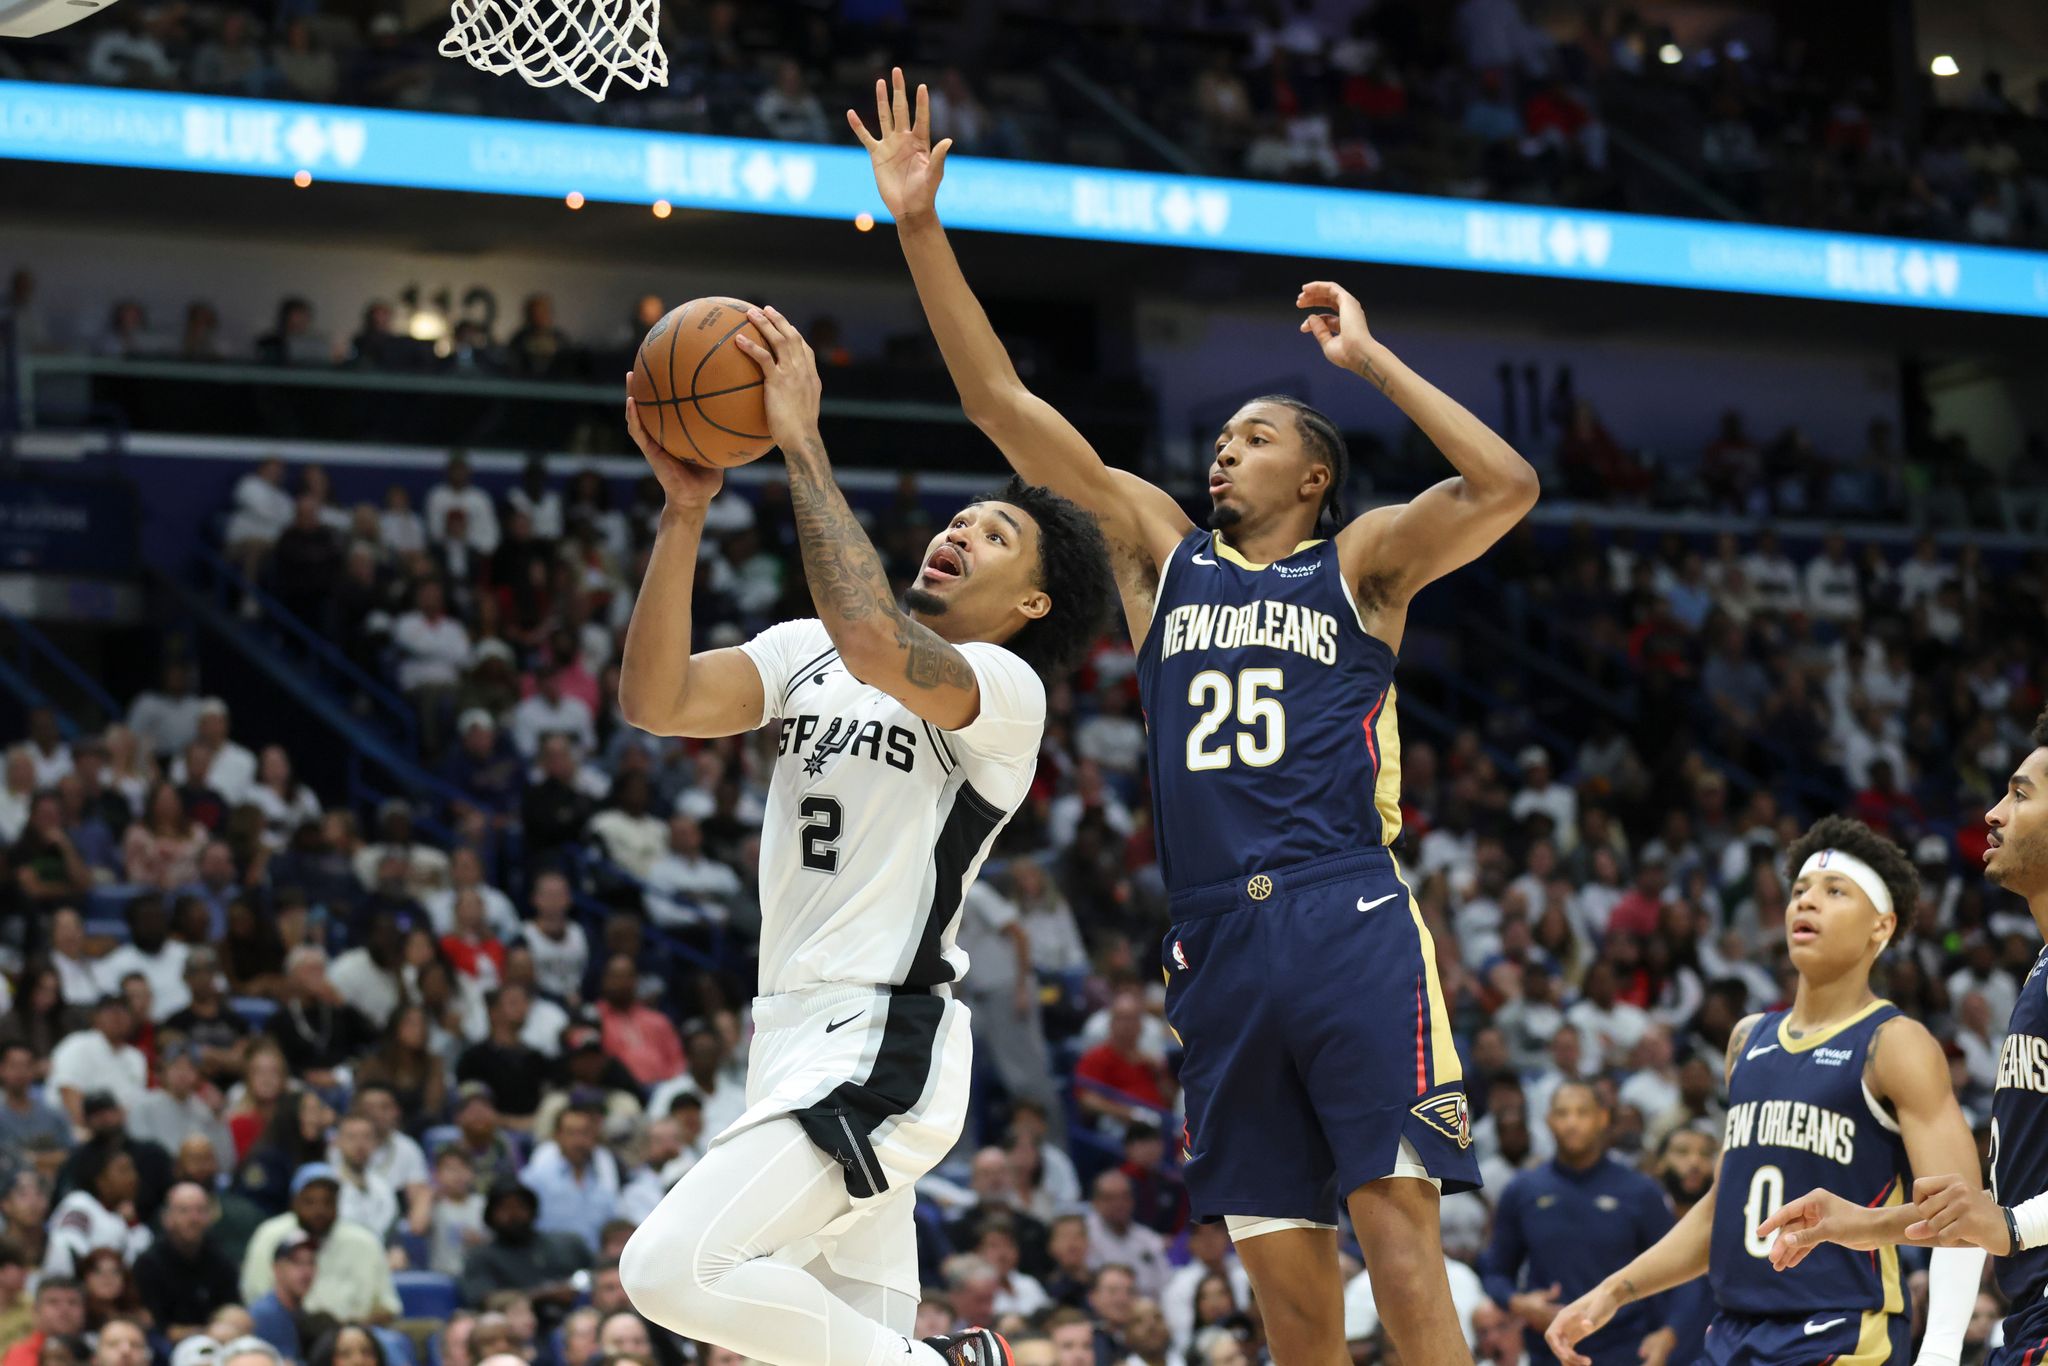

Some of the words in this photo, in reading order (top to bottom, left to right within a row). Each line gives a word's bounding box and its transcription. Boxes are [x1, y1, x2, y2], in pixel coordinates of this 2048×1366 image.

[183, 105, 283, 164] BLUE
[645, 142, 738, 198] BLUE
[1272, 560, 1322, 573] NEWAGE
[1214, 600, 1338, 666] ORLEANS
[778, 714, 917, 778] SPURS
[1186, 667, 1286, 772] 25
[798, 793, 844, 875] 2
[1757, 1100, 1855, 1165] ORLEANS
[1743, 1165, 1784, 1258] 0
